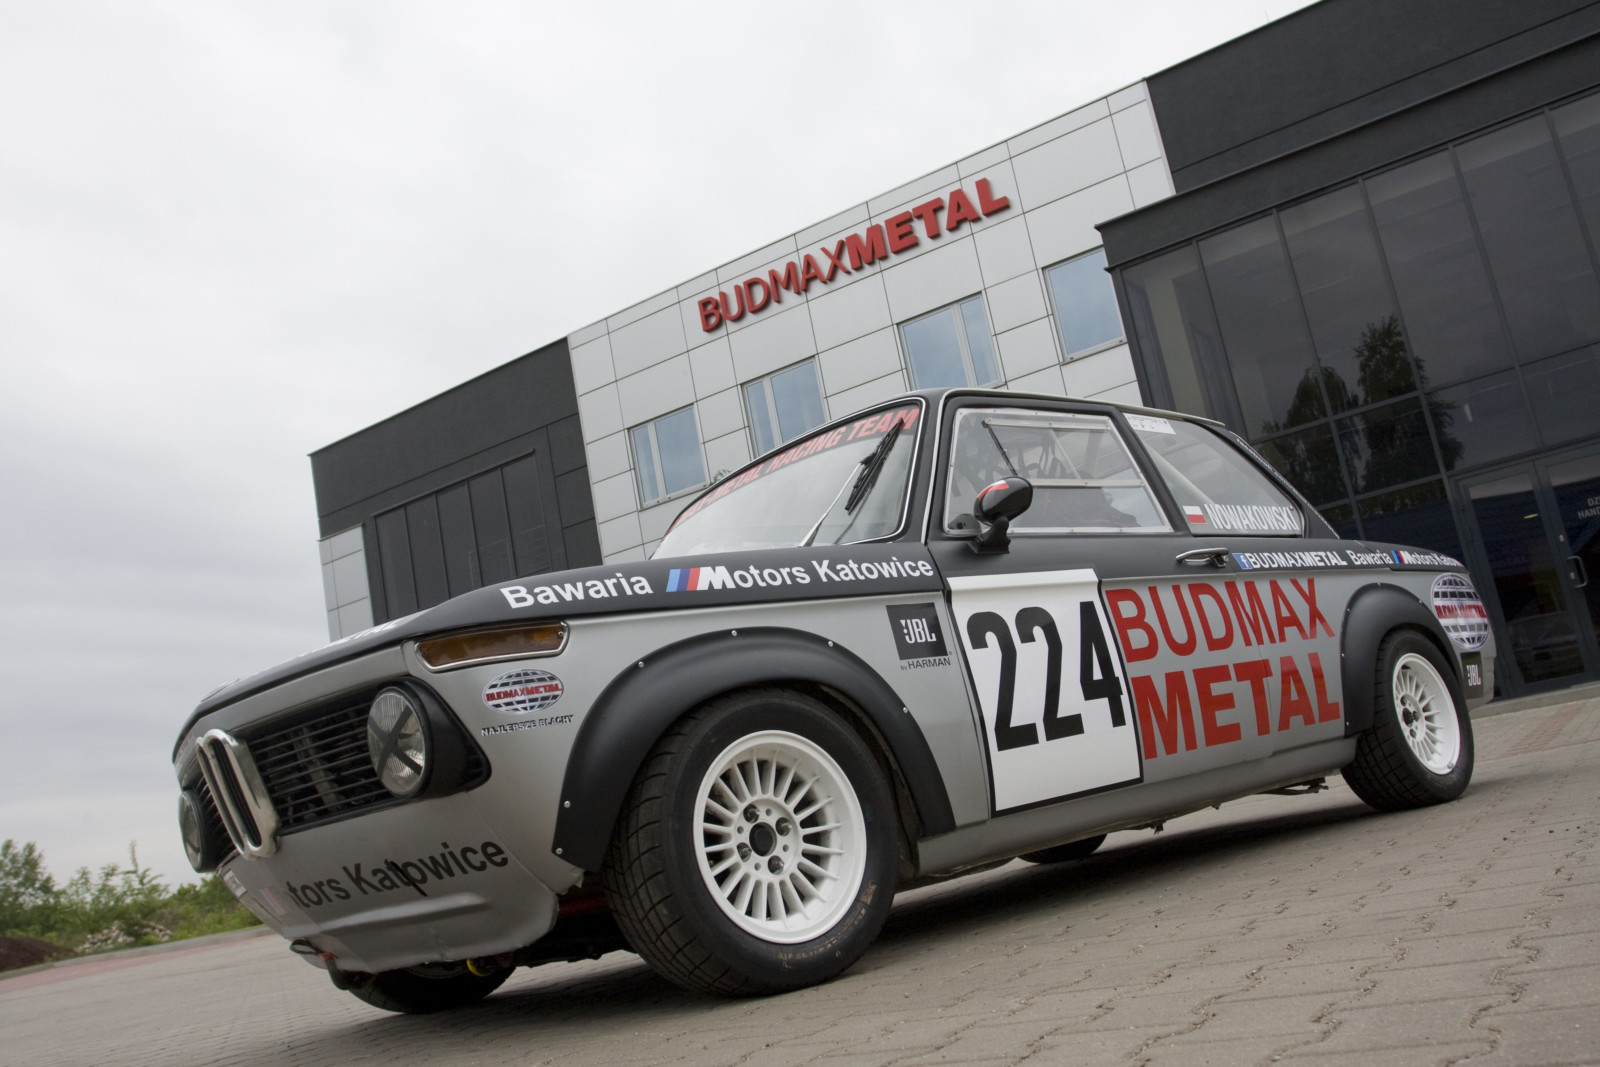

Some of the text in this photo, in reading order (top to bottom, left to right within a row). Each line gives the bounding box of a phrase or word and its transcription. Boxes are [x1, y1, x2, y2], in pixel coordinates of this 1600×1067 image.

[697, 177, 1010, 333] BUDMAXMETAL
[764, 427, 847, 476] RACING
[846, 408, 920, 442] TEAM
[1204, 503, 1300, 531] NOWAKOWSKI
[1244, 551, 1348, 569] BUDMAXMETAL
[1345, 549, 1394, 566] Bawaria
[500, 557, 935, 609] Bawaria Motors Katowice
[900, 618, 937, 644] JBL
[1105, 577, 1336, 664] BUDMAX
[907, 657, 951, 670] HARMAN
[966, 600, 1127, 752] 224
[1466, 664, 1482, 687] JBL
[486, 683, 563, 702] BUDMAXMETAL
[1130, 652, 1341, 760] METAL
[481, 719, 537, 737] NAJLEPSZE
[342, 841, 509, 896] Katowice
